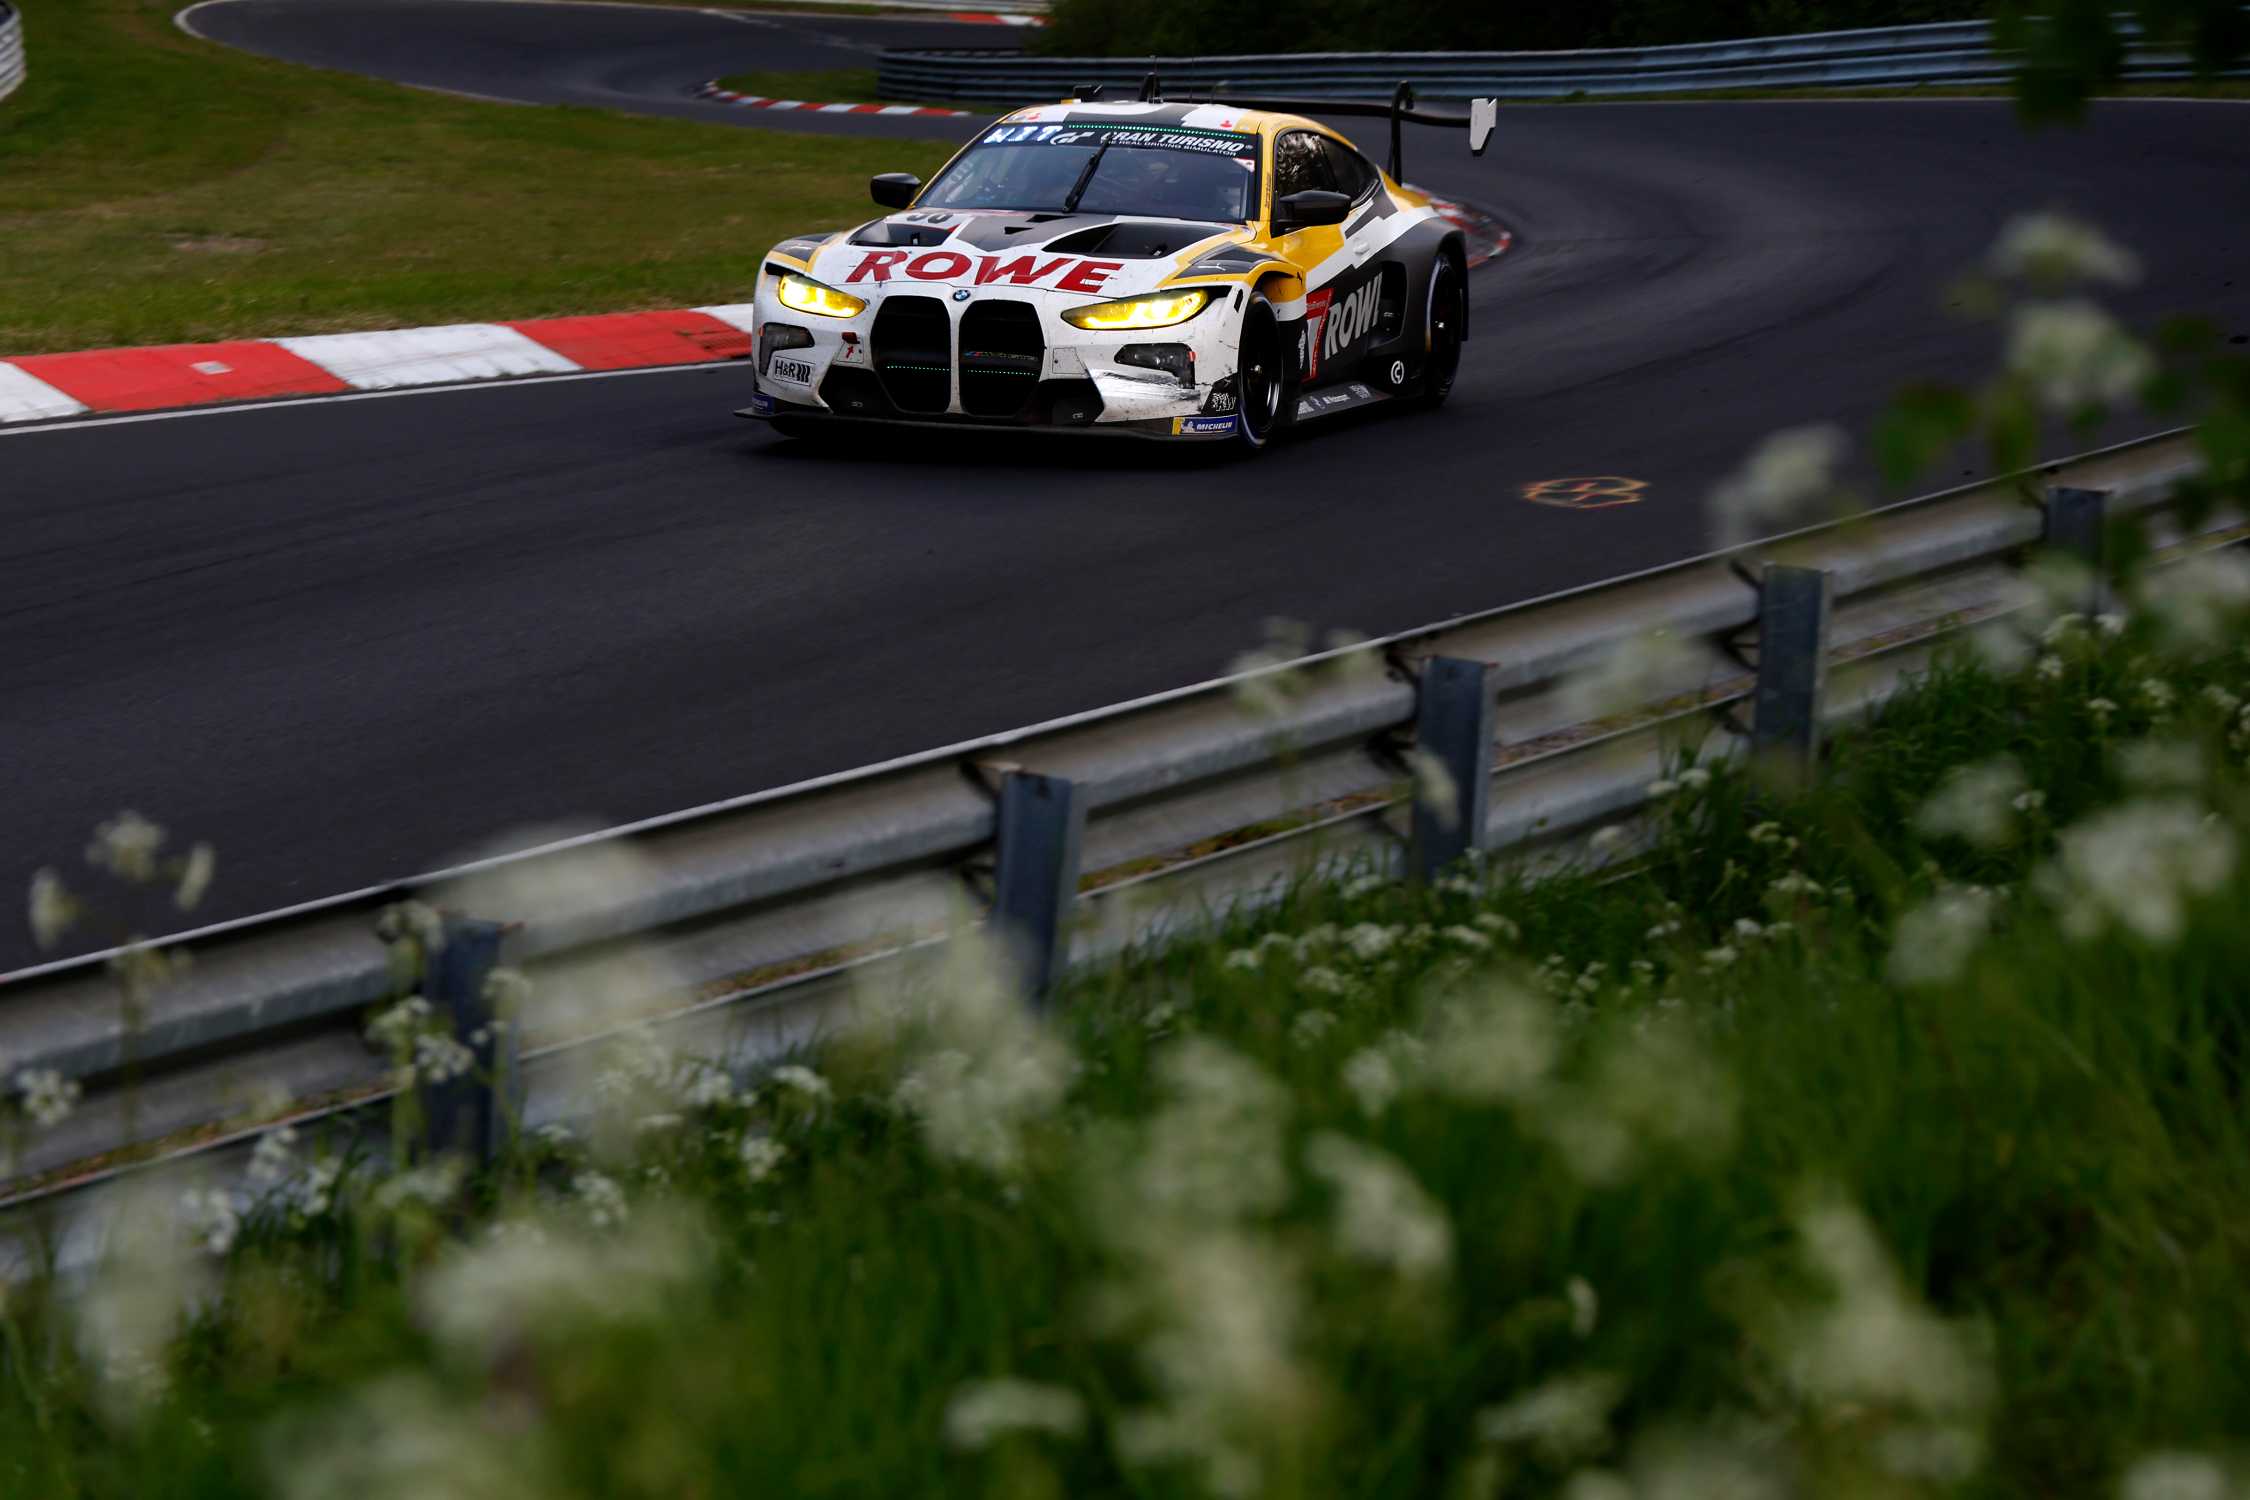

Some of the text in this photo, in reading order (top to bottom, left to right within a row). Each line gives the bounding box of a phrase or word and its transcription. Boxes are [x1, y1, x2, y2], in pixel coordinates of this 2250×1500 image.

[1158, 133, 1245, 152] TURISMO
[845, 250, 1126, 294] ROWE
[1196, 421, 1234, 430] MICHELIN
